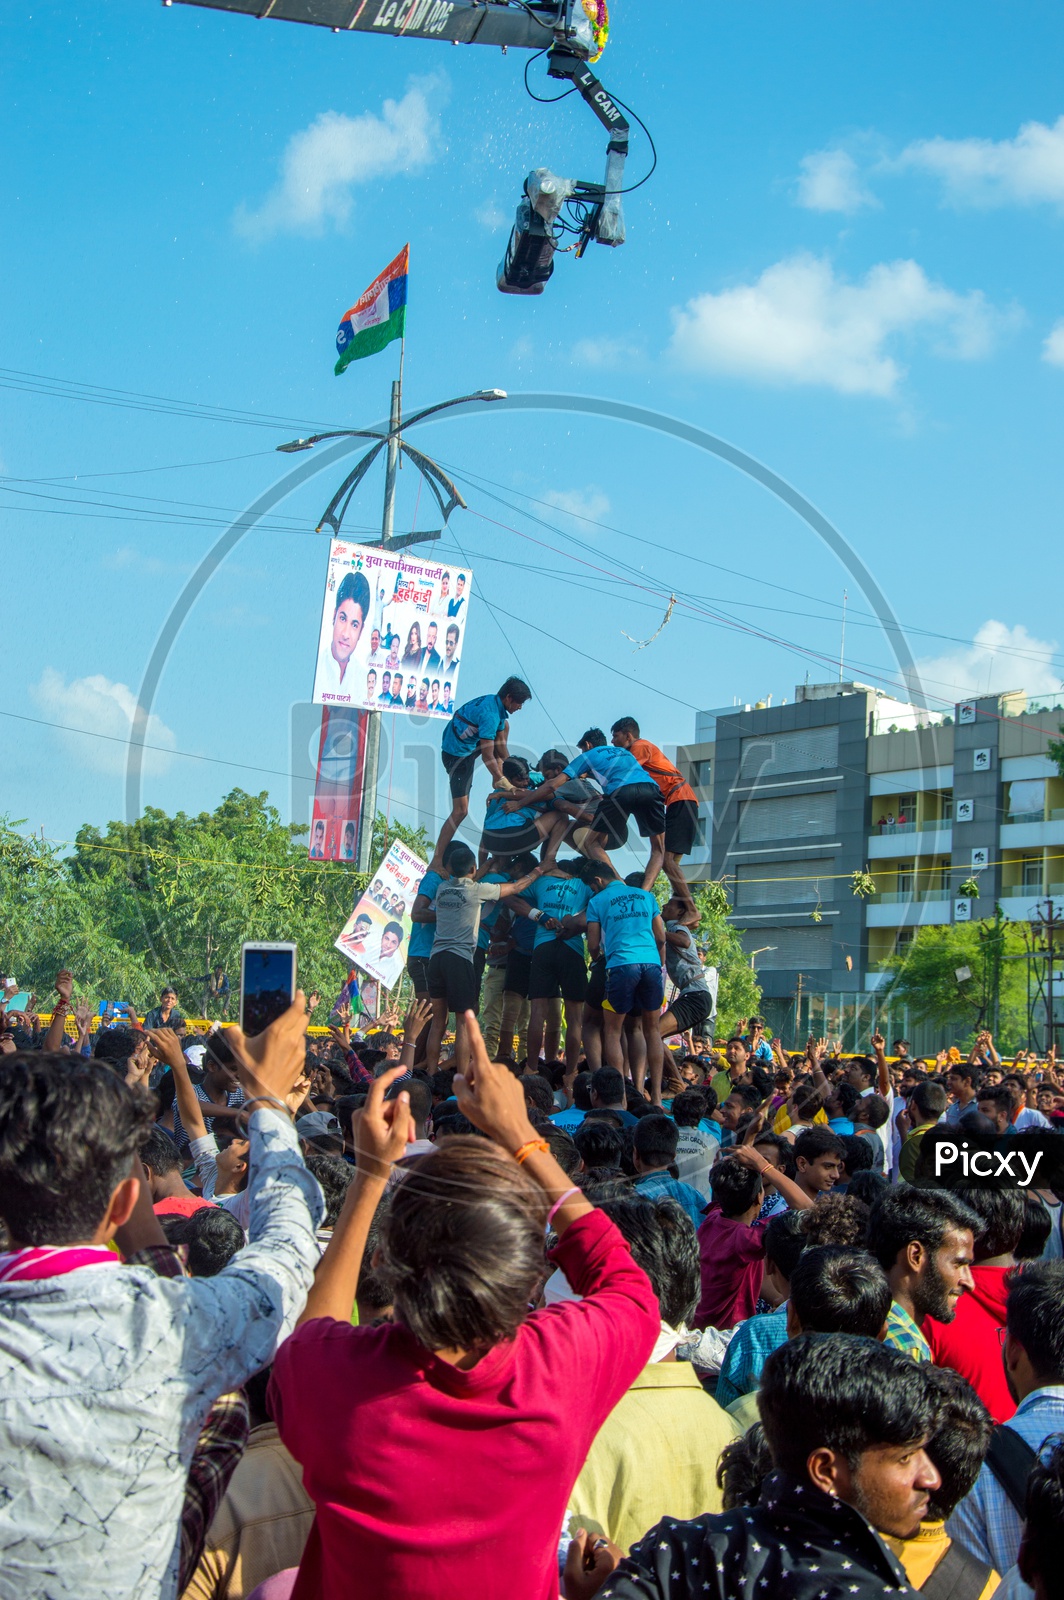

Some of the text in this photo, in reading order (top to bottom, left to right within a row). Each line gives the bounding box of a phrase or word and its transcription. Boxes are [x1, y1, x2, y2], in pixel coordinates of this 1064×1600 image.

[373, 0, 398, 27] Le
[594, 90, 621, 122] CAM
[366, 555, 443, 580] युवा स्वाभिमान पार्टी
[557, 890, 565, 903] 9
[610, 893, 646, 907] ADARSH GROUP
[617, 899, 635, 913] 37
